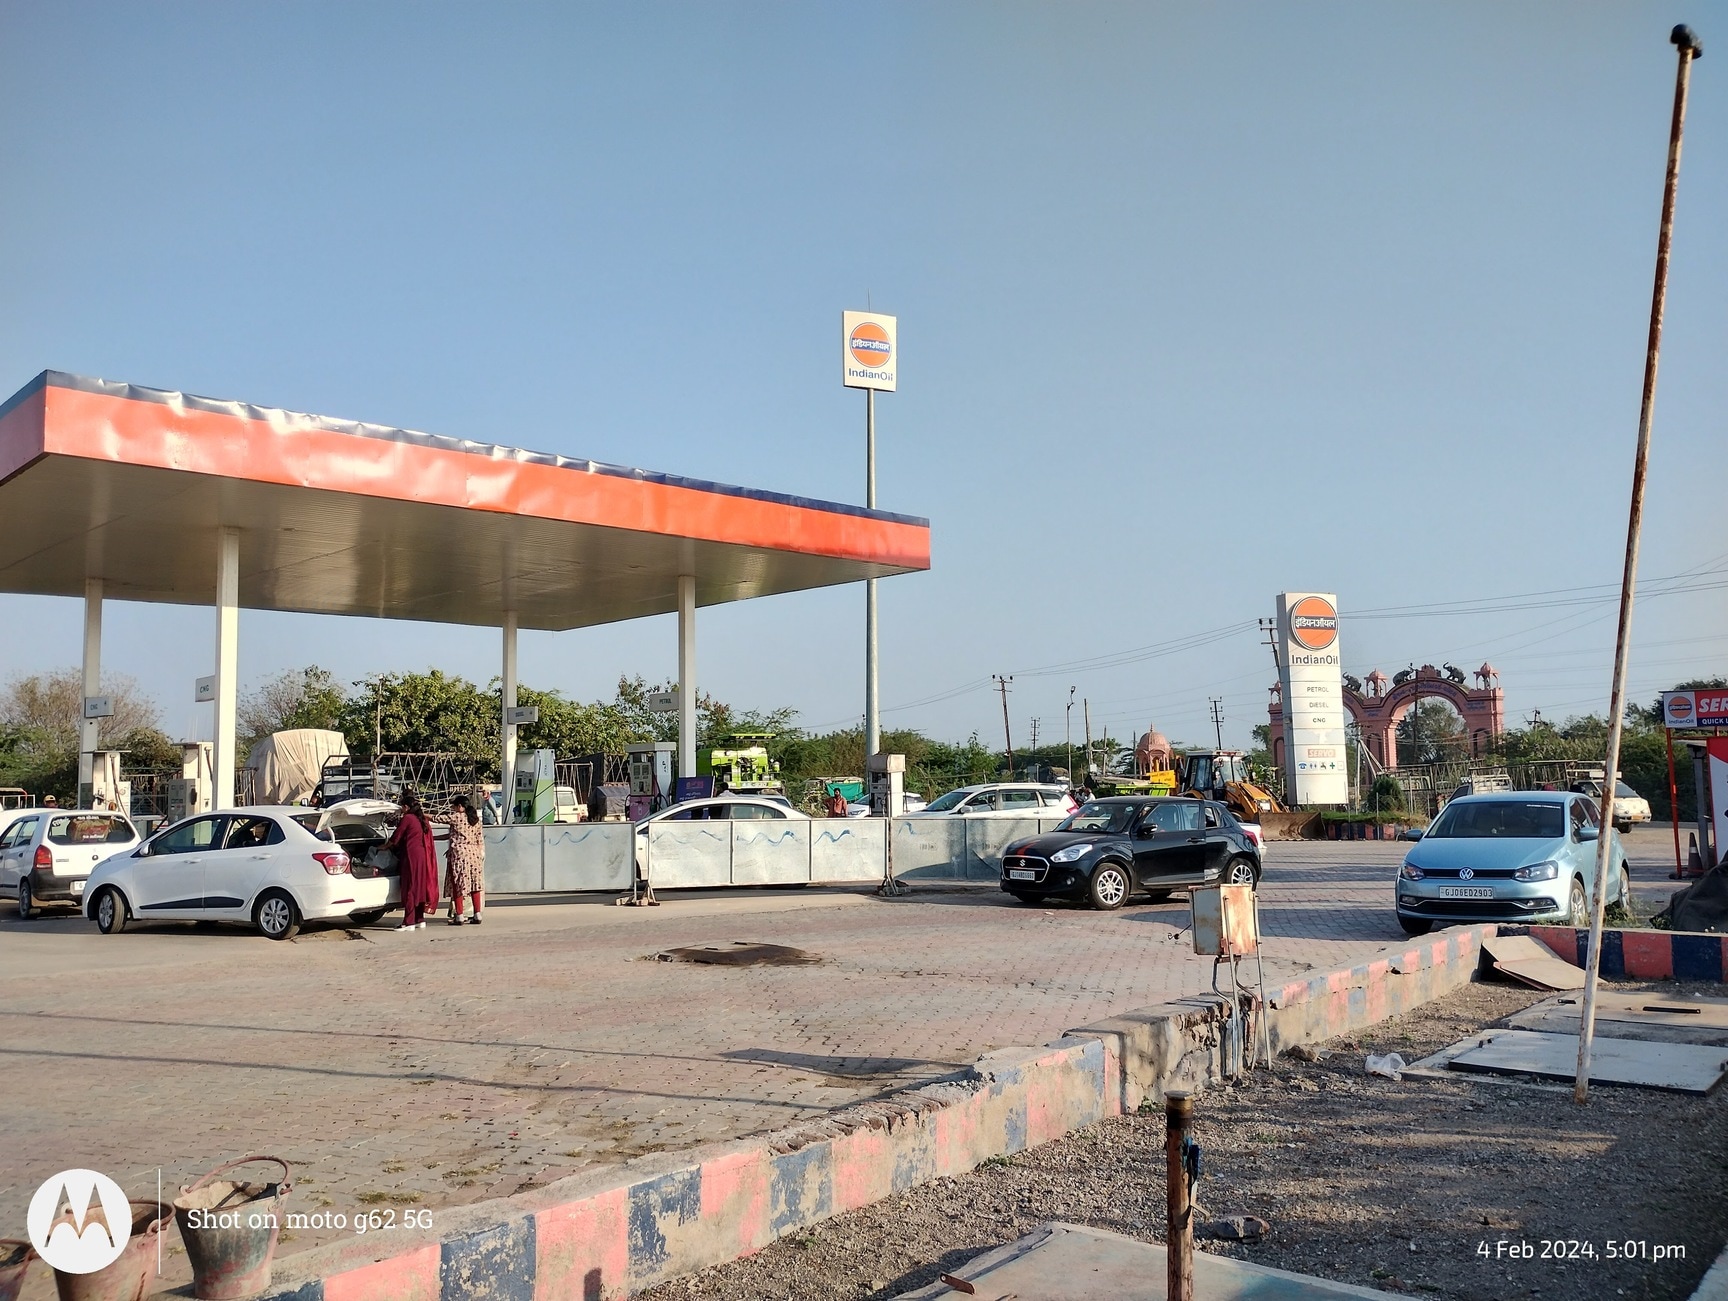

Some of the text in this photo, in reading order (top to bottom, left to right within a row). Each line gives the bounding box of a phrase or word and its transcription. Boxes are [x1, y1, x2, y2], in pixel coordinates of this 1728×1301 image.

[848, 368, 892, 380] IndianOil
[1295, 616, 1335, 628] इंडियनऑयल
[1291, 654, 1339, 665] IndianOil
